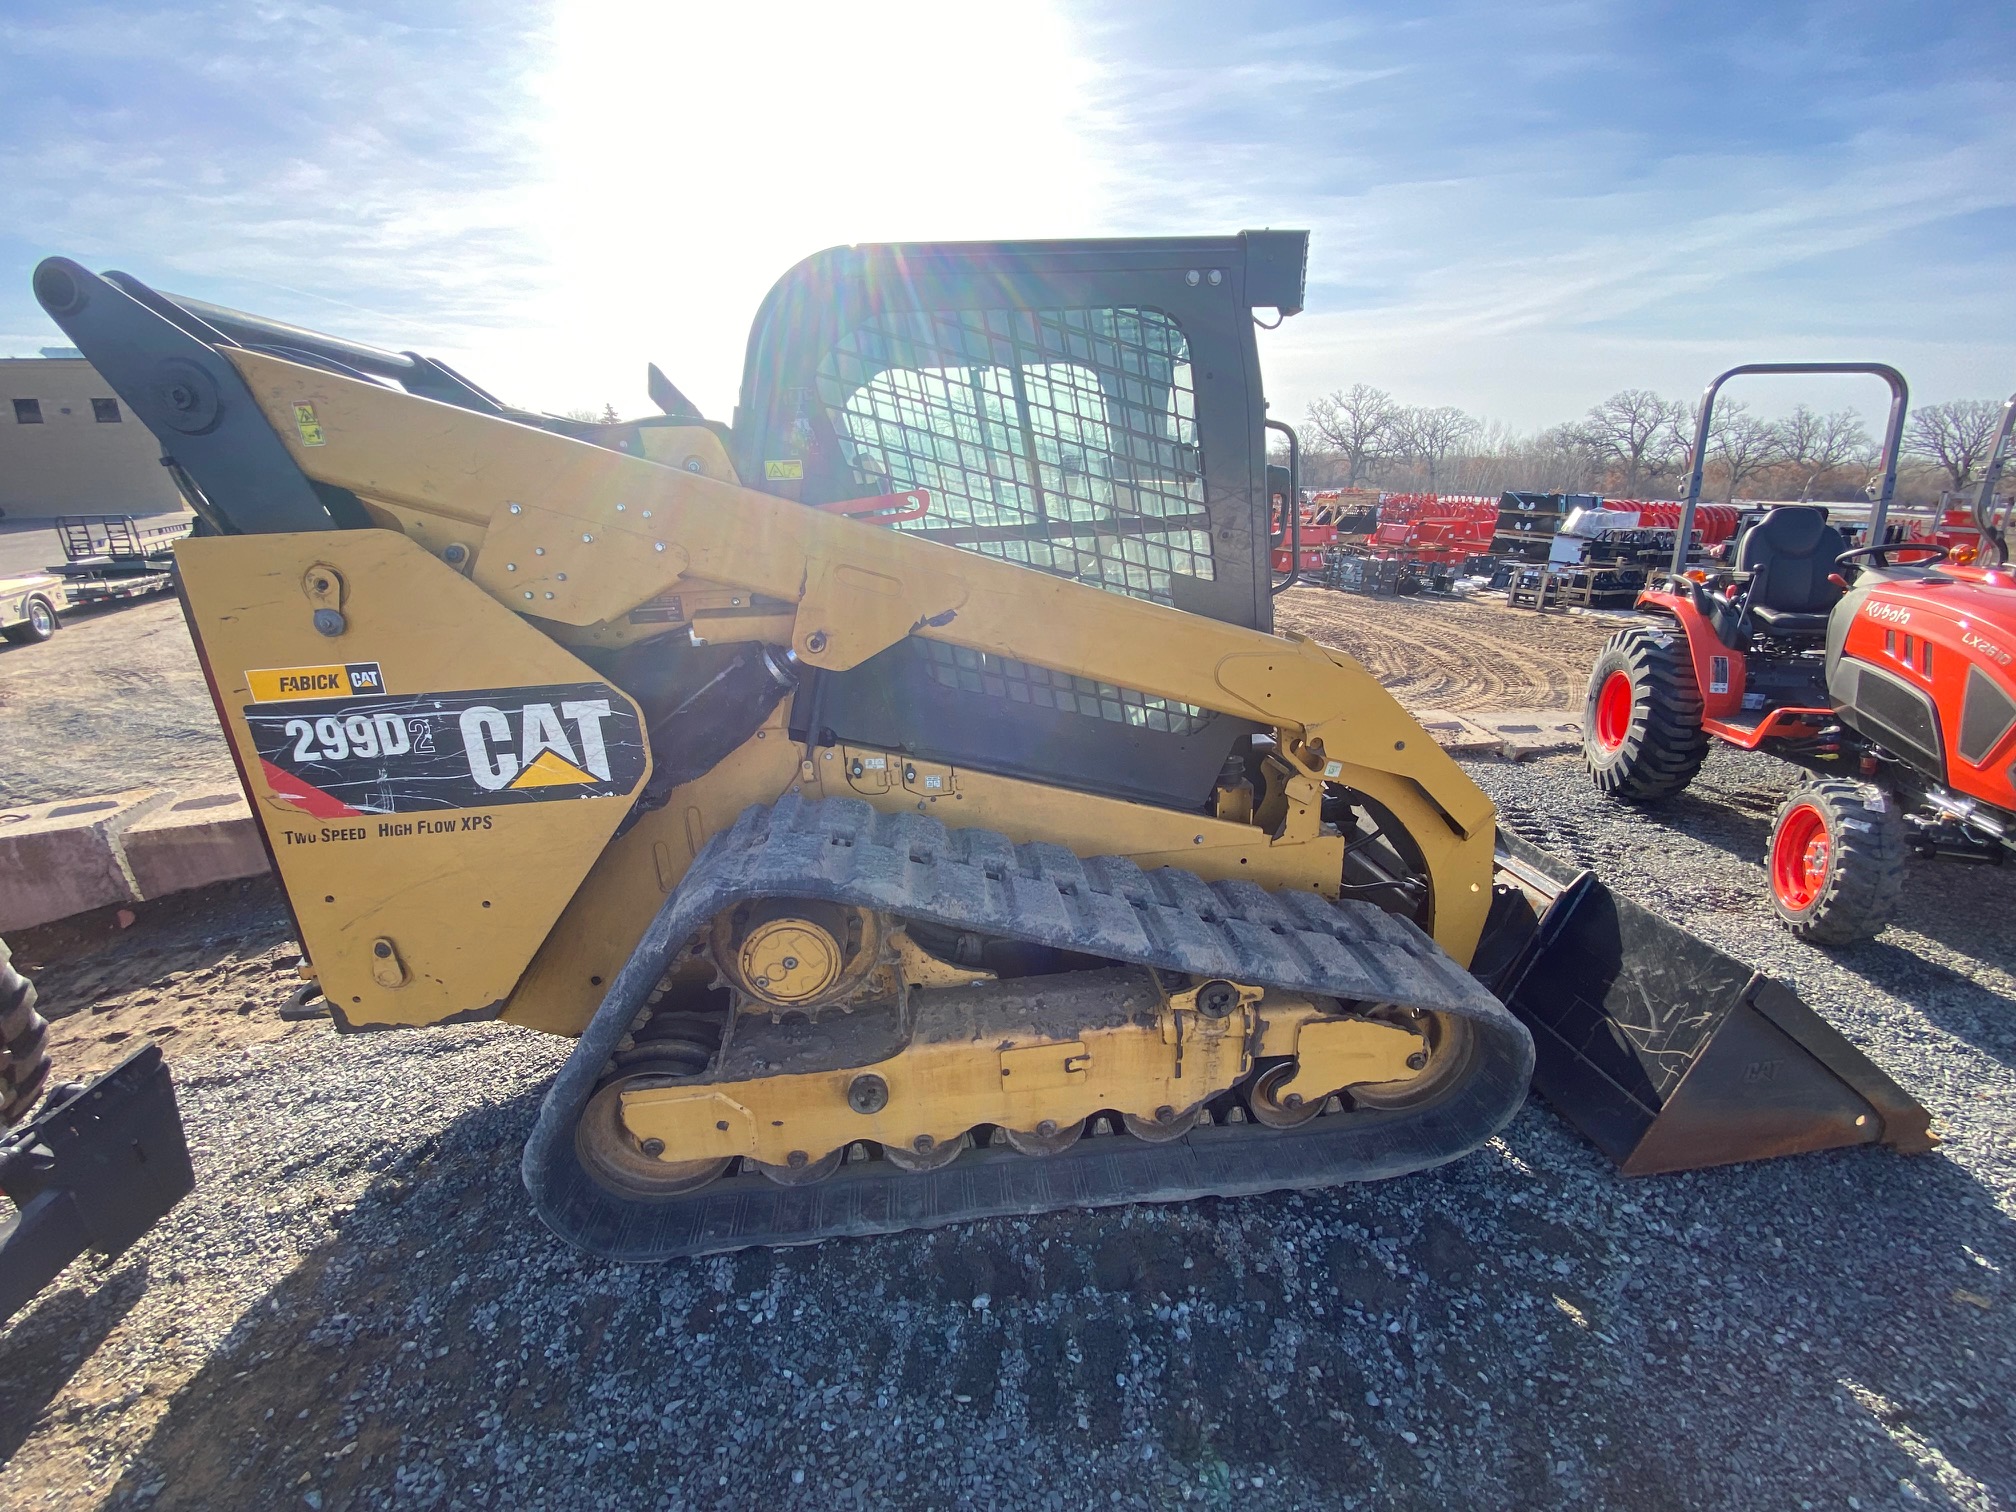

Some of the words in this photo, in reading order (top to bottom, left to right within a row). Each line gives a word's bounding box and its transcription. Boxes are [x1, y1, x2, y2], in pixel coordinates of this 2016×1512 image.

[1865, 601, 1912, 625] Kubota
[1961, 632, 2013, 667] LX2610
[279, 673, 340, 692] FABICK
[350, 671, 379, 688] CAT
[458, 699, 612, 790] CAT
[320, 827, 367, 843] SPEED
[378, 822, 413, 838] HIGH
[417, 820, 456, 835] FLOW
[461, 815, 493, 832] XPS
